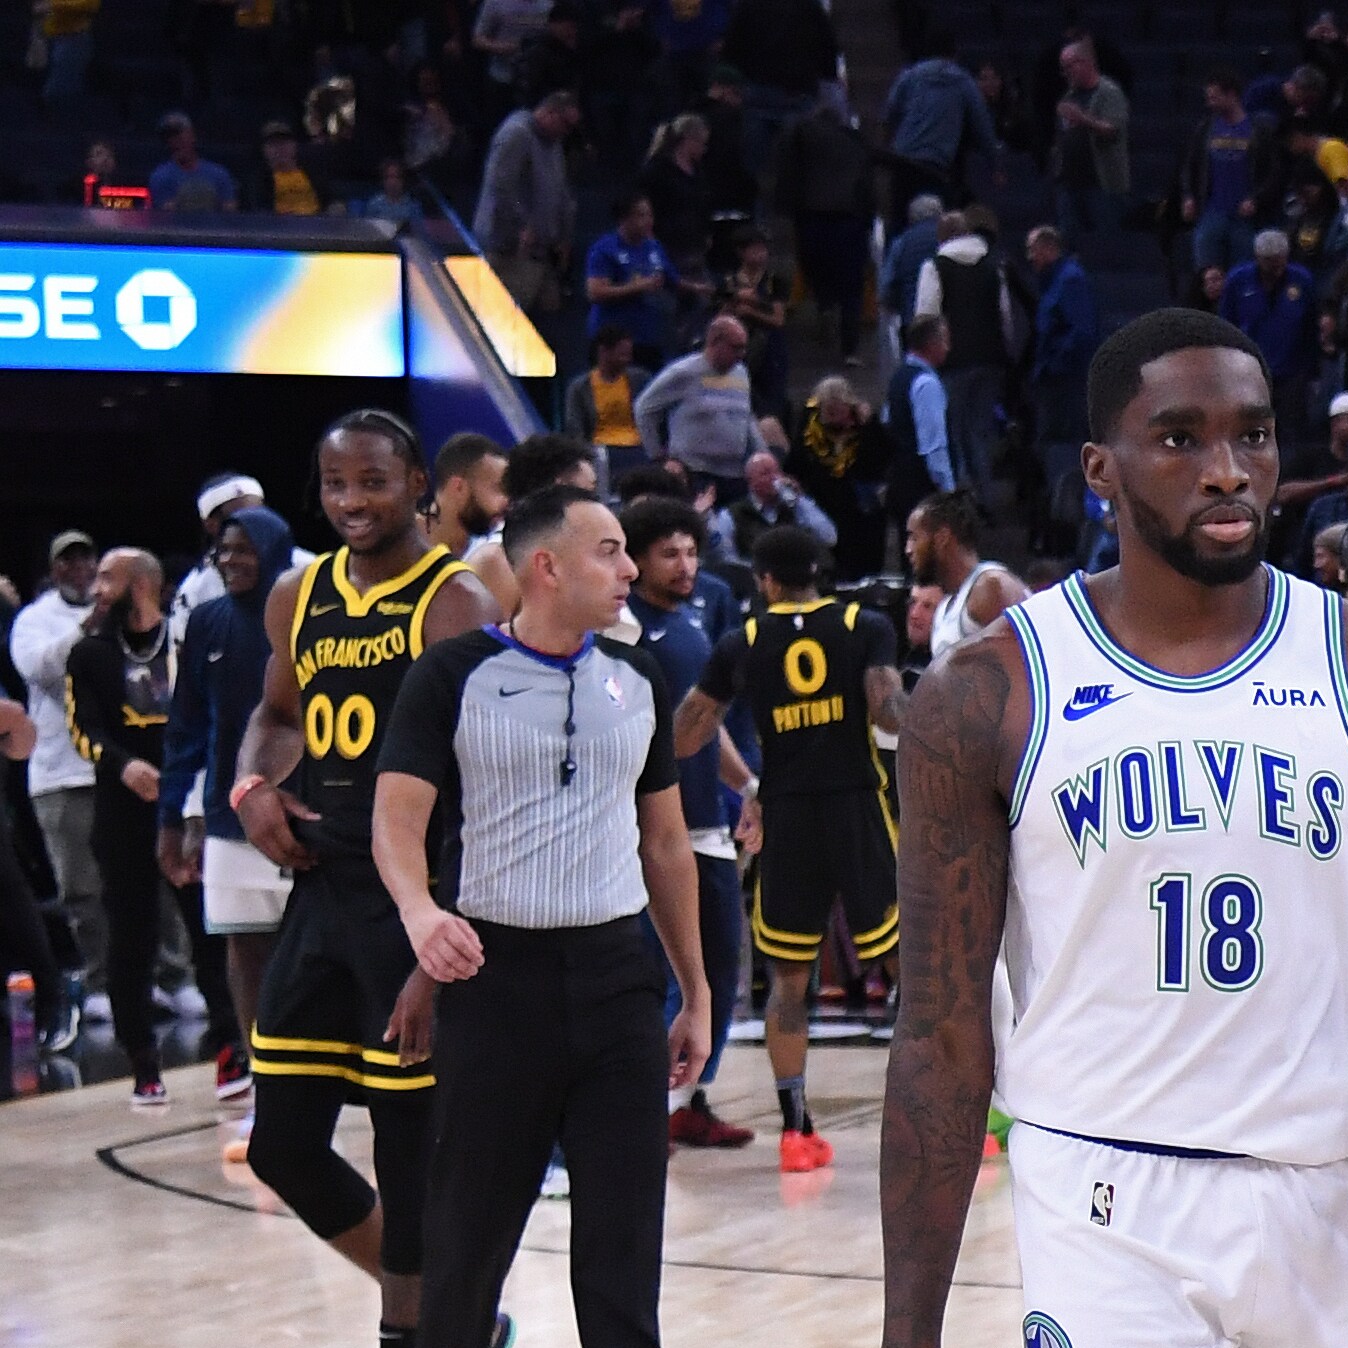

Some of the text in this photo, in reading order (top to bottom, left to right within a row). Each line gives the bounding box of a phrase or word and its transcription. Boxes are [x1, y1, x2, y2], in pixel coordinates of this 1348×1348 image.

[296, 624, 406, 691] AN FRANCISCO
[784, 638, 828, 697] 0
[306, 692, 376, 761] 00
[1073, 684, 1115, 706] NIKE
[1051, 739, 1345, 870] WOLVES
[1150, 872, 1264, 994] 18
